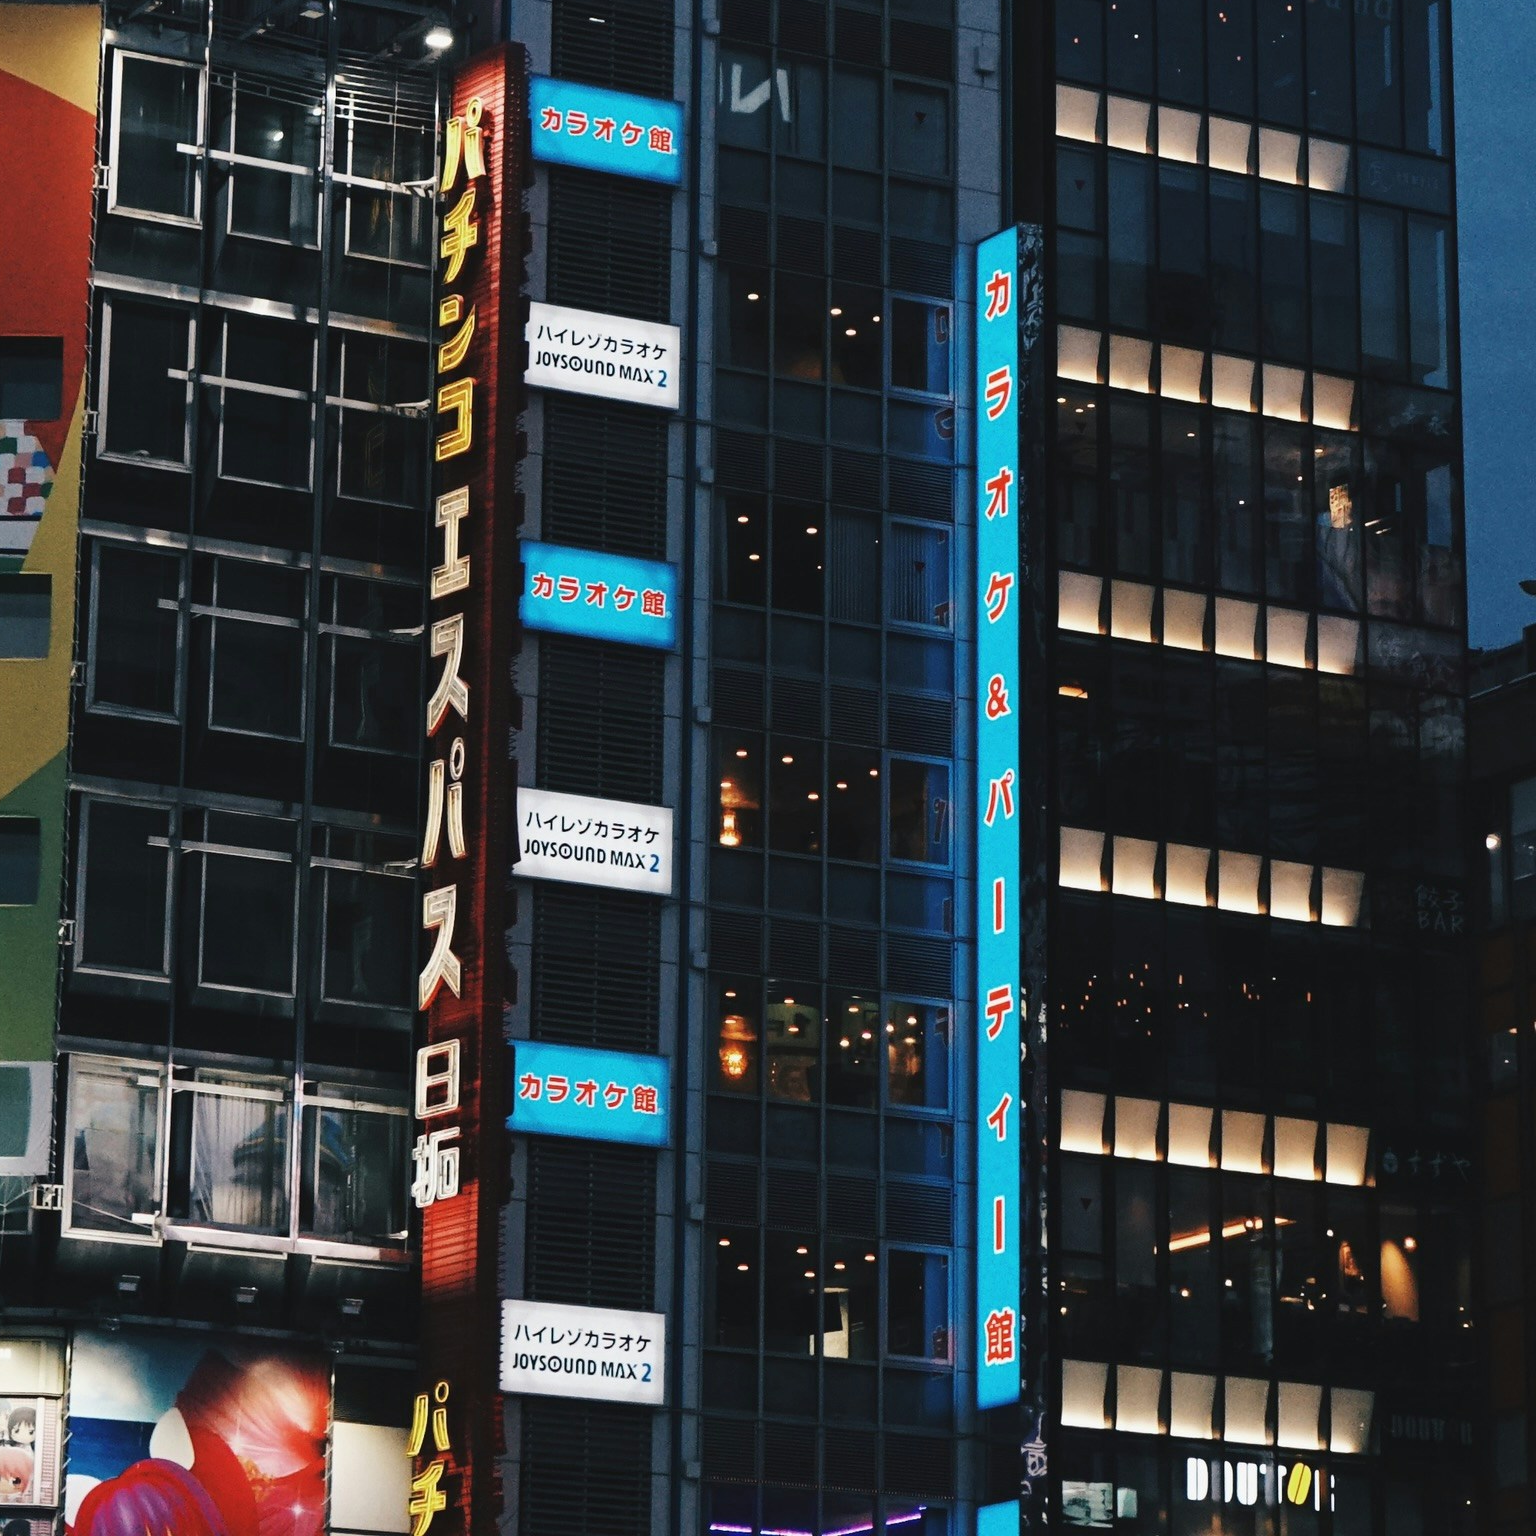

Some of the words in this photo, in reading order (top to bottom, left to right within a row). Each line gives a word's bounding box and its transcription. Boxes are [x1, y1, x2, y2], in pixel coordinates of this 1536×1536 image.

[540, 106, 673, 153] カラオケ館
[435, 97, 486, 463] パチンコ
[537, 324, 667, 361] ハイレゾカラオケ
[535, 349, 616, 379] JOYSOUND
[618, 364, 654, 385] MAX
[656, 369, 668, 389] 2
[532, 572, 666, 618] カラオケ館
[418, 485, 469, 1011] エスパス
[525, 810, 659, 845] ハイレゾカラオケ
[524, 839, 606, 866] JOYSOUND
[609, 849, 646, 869] MAX
[648, 852, 660, 873] 2
[519, 1071, 657, 1113] カラオケ館
[513, 1321, 652, 1354] ハイレゾカラオケ
[512, 1351, 597, 1377] JOYSOUND
[599, 1360, 638, 1382] MAX
[640, 1362, 653, 1384] 2
